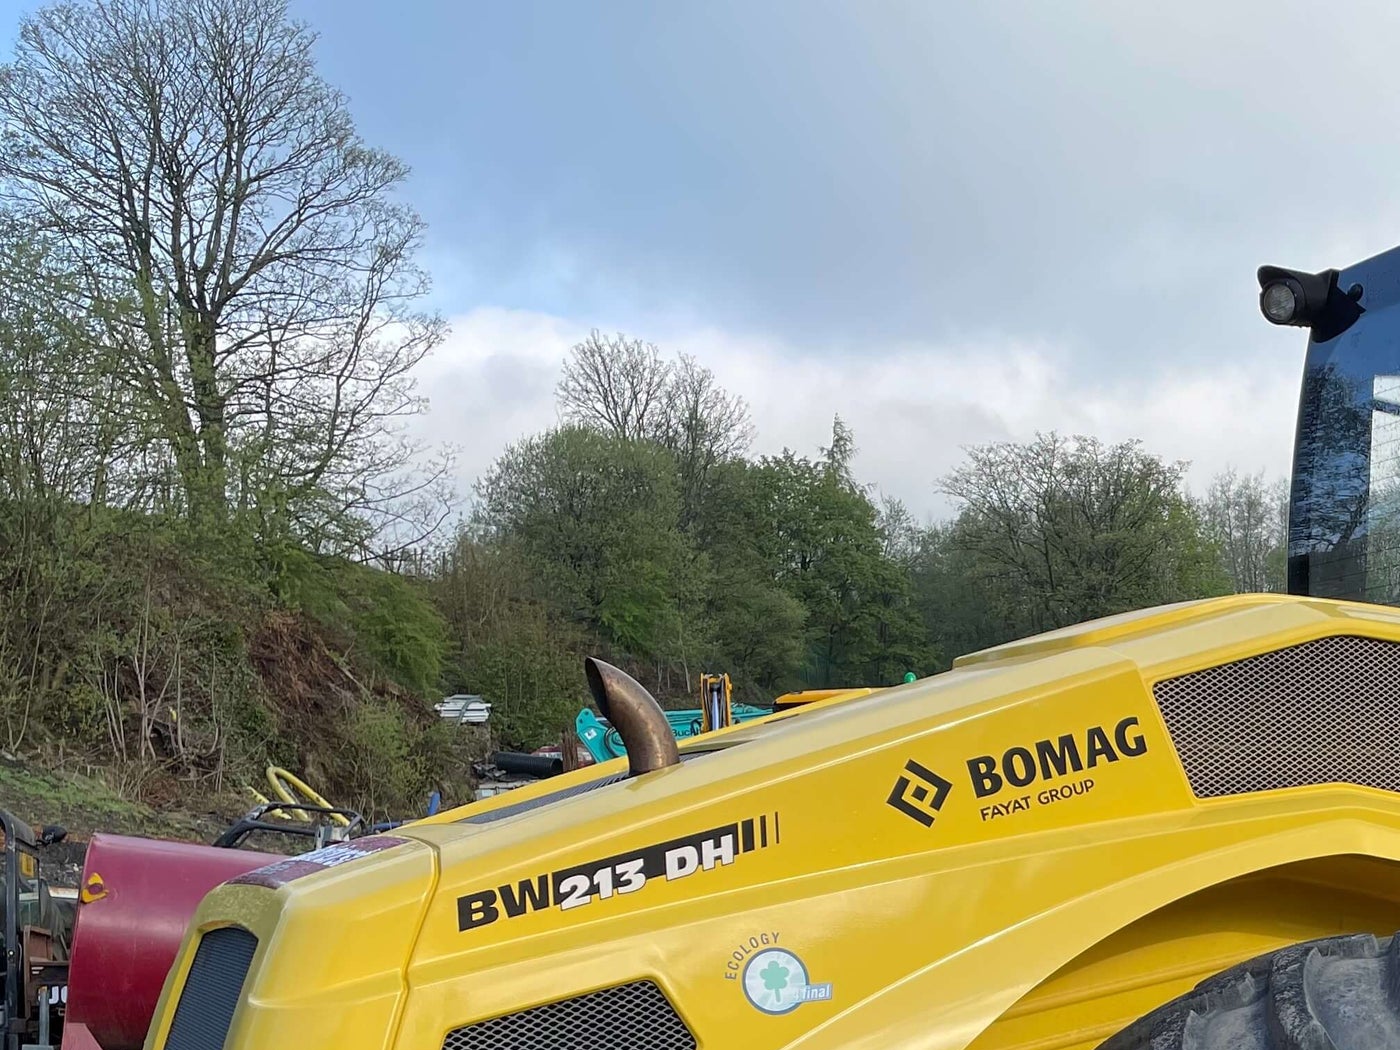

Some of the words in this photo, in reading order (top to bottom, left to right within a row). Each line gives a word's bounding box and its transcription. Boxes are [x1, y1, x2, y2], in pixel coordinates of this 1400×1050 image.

[967, 716, 1148, 798] BOMAG
[980, 795, 1031, 821] FAYAT
[1037, 778, 1095, 805] GROUP
[665, 833, 735, 881] DH
[725, 932, 779, 980] ECOLOGY
